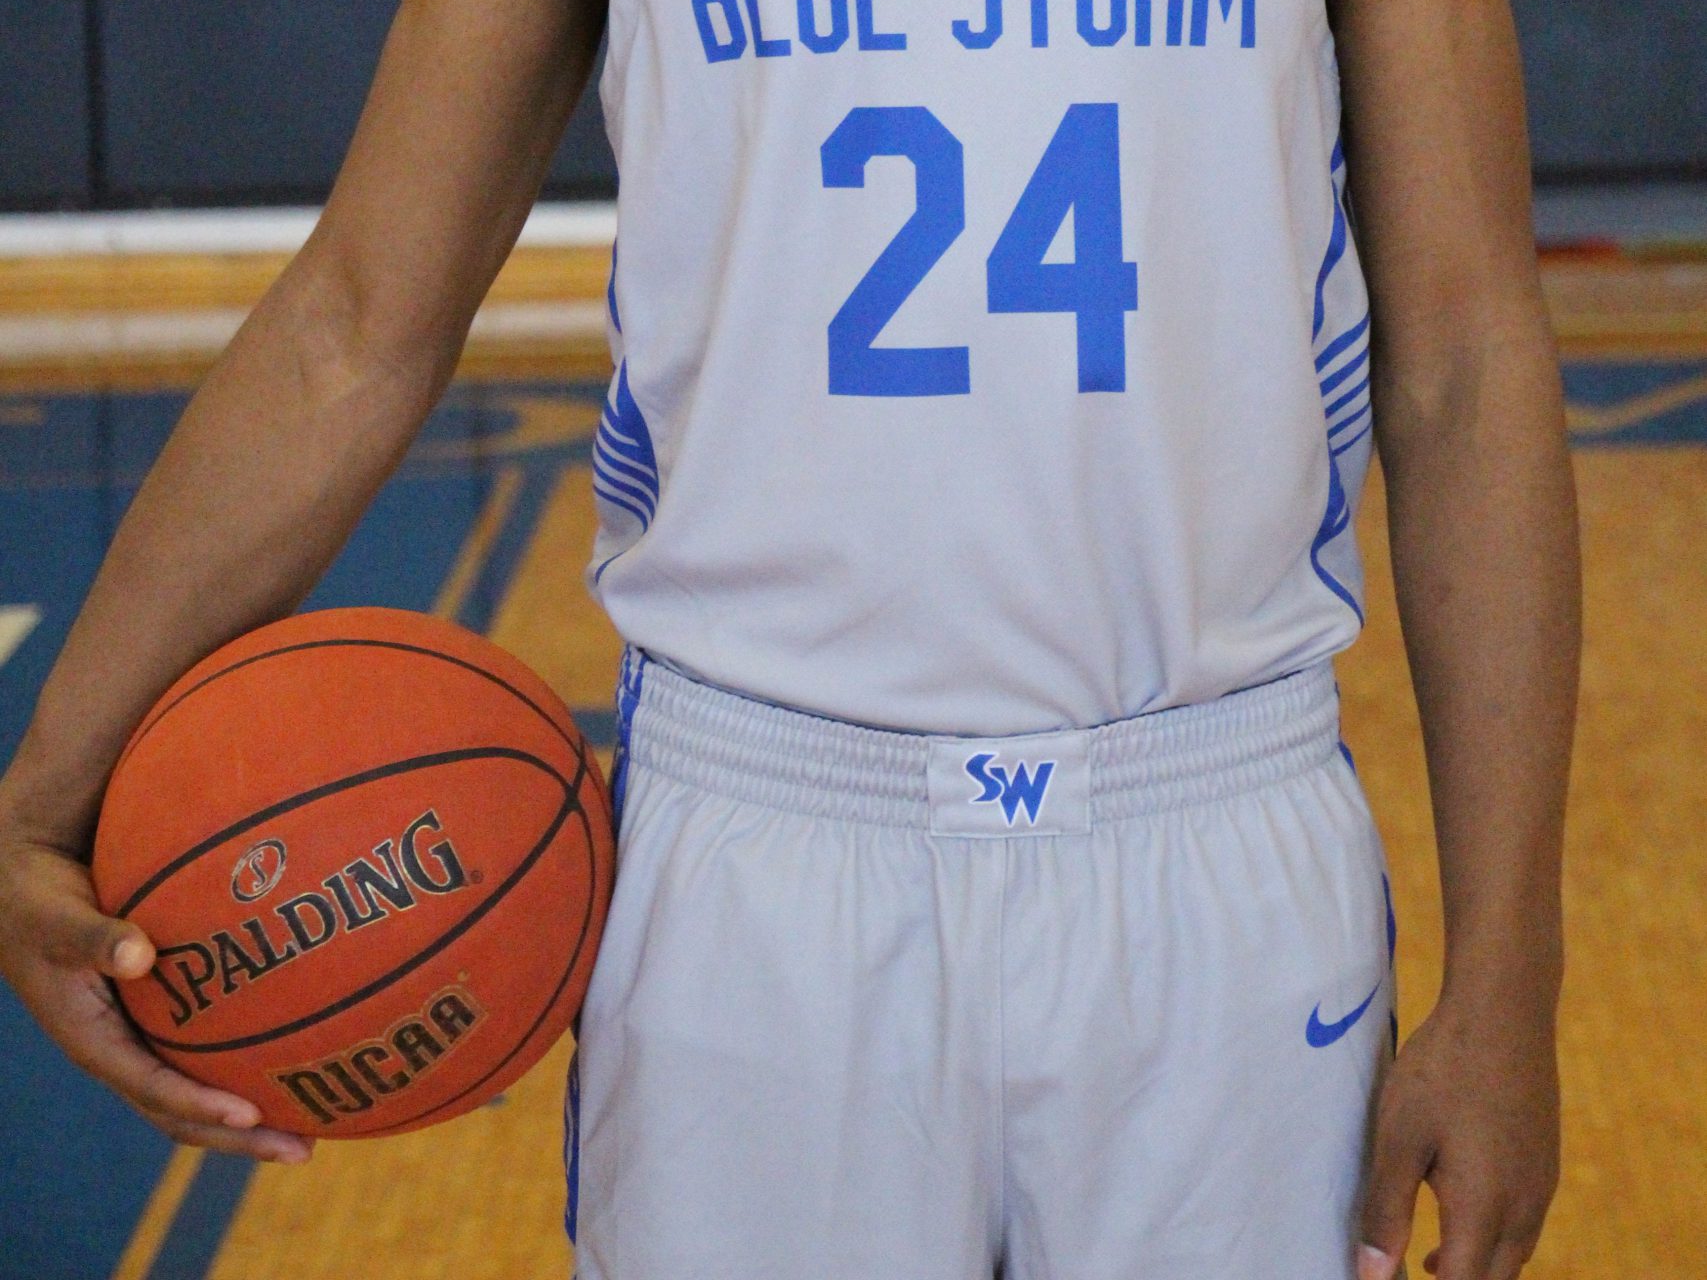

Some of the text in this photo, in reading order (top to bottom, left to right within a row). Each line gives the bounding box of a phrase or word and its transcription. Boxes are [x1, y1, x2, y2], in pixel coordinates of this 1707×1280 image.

[820, 102, 1138, 397] 24
[965, 753, 1055, 827] SW
[151, 809, 466, 1027] SPALDING
